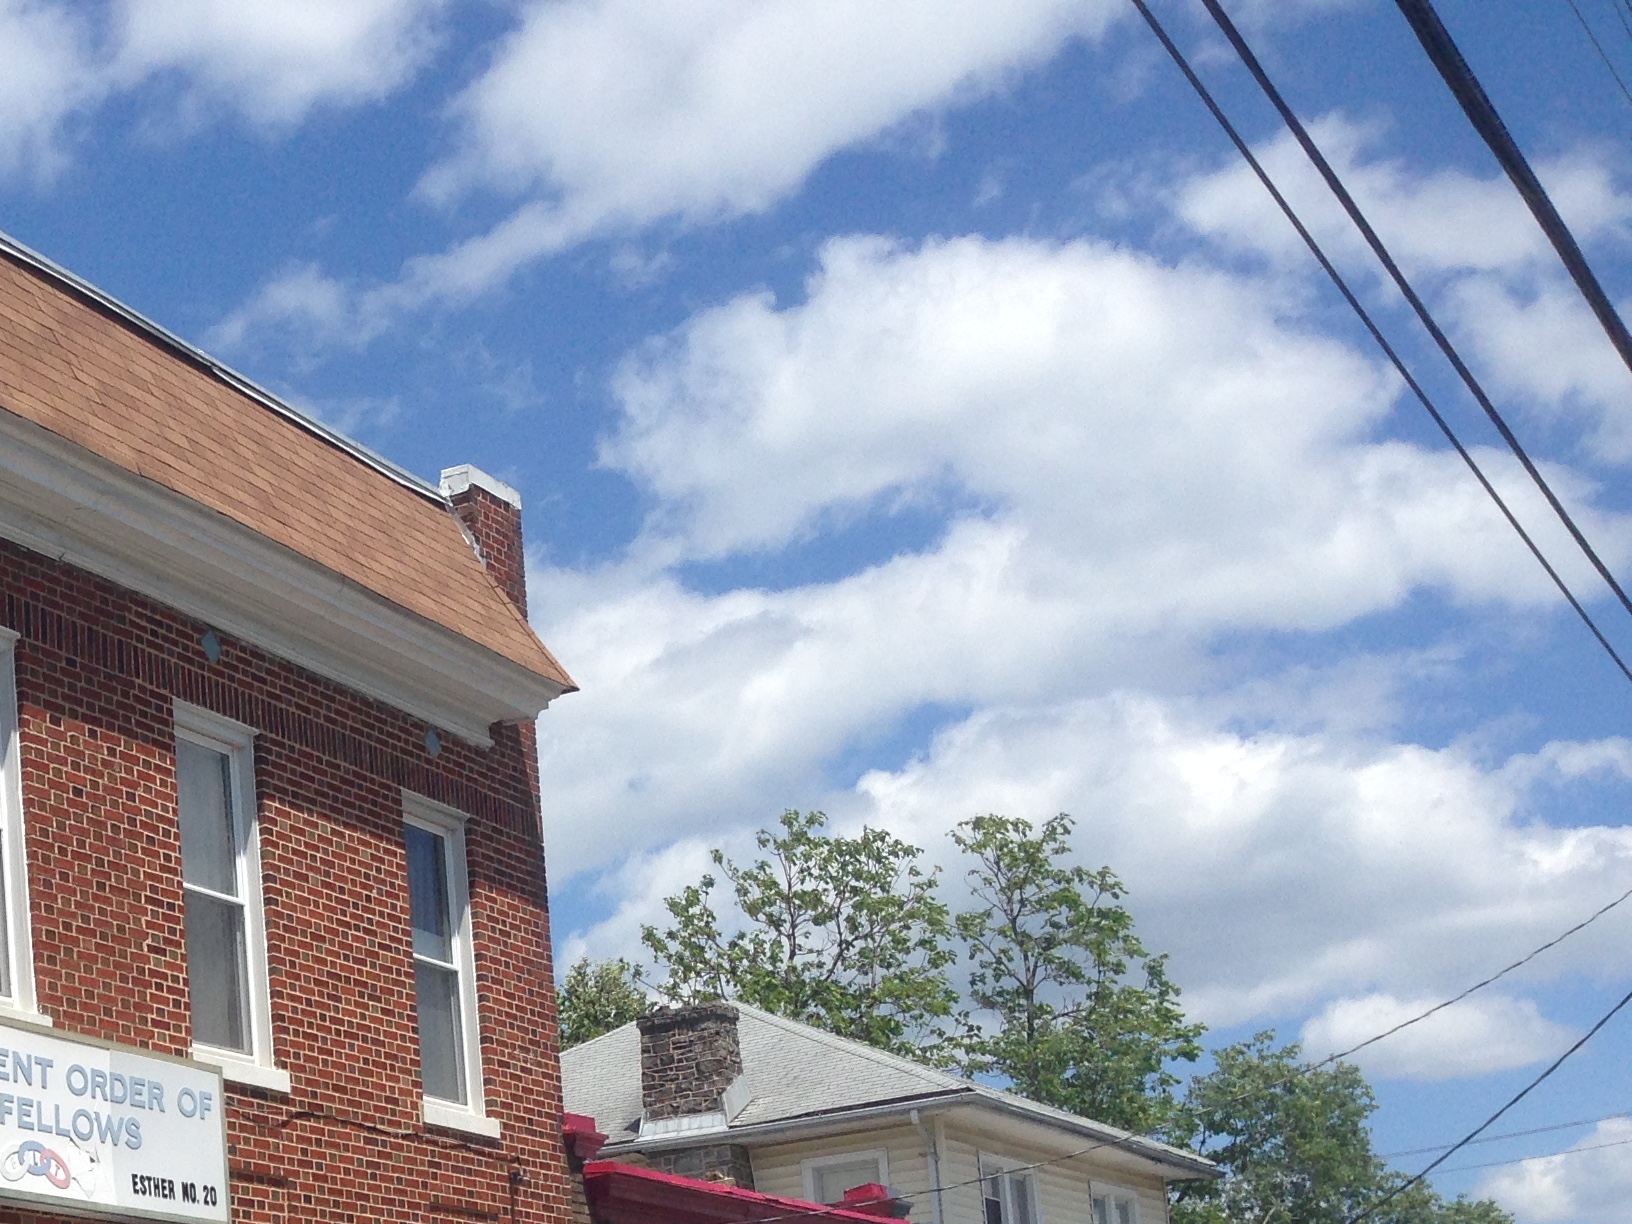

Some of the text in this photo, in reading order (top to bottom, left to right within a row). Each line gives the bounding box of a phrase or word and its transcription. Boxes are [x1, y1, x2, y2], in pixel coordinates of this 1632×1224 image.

[66, 1064, 165, 1113] ORDER
[177, 1087, 212, 1120] OF
[0, 1093, 142, 1150] FELLOWS
[131, 1173, 217, 1207] ESTHER NO. 20
